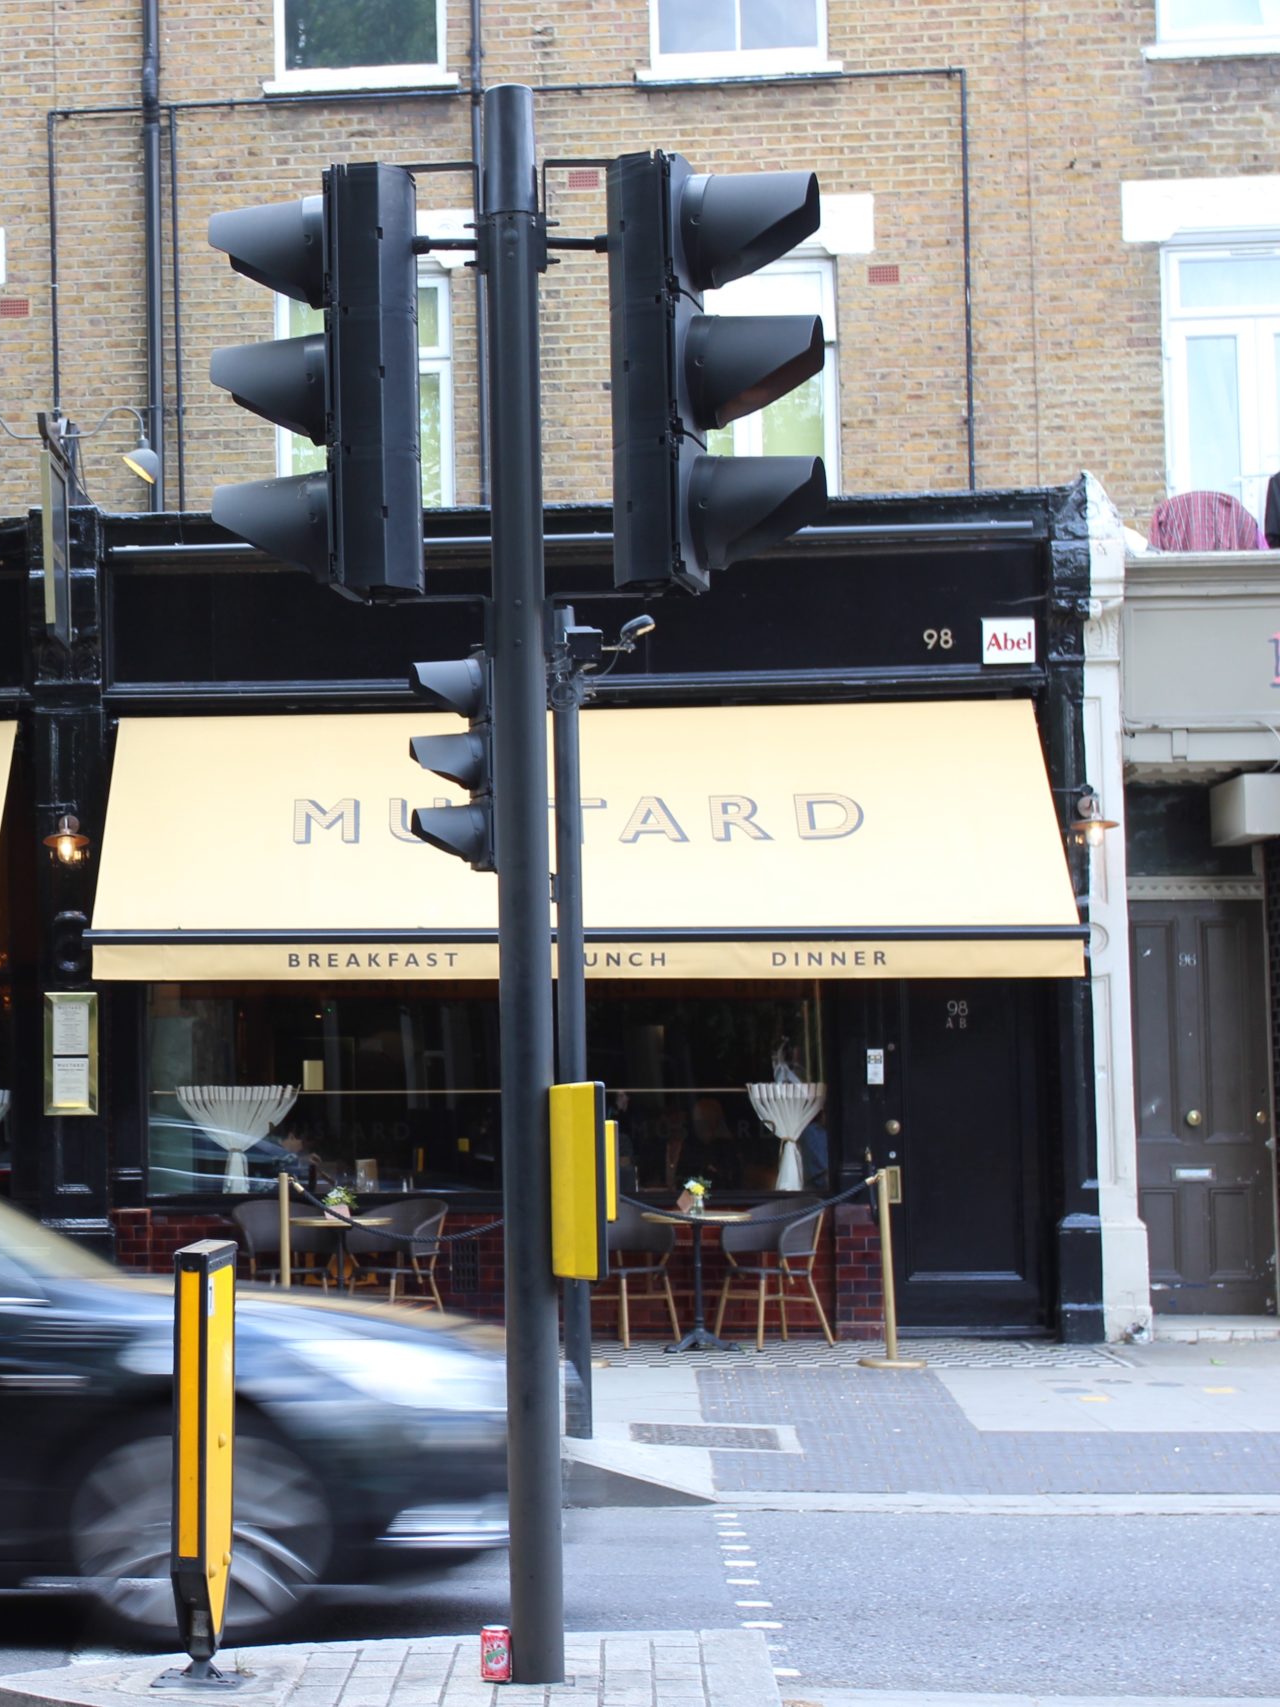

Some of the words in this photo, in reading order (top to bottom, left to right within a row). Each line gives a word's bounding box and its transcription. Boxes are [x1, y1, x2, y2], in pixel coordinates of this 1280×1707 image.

[923, 628, 954, 650] 98
[986, 631, 1033, 651] Abel
[293, 793, 865, 845] MUARD
[288, 953, 458, 968] BREAKFAST
[583, 952, 666, 967] UNCH
[773, 951, 887, 967] DINNER
[947, 1000, 968, 1016] 98
